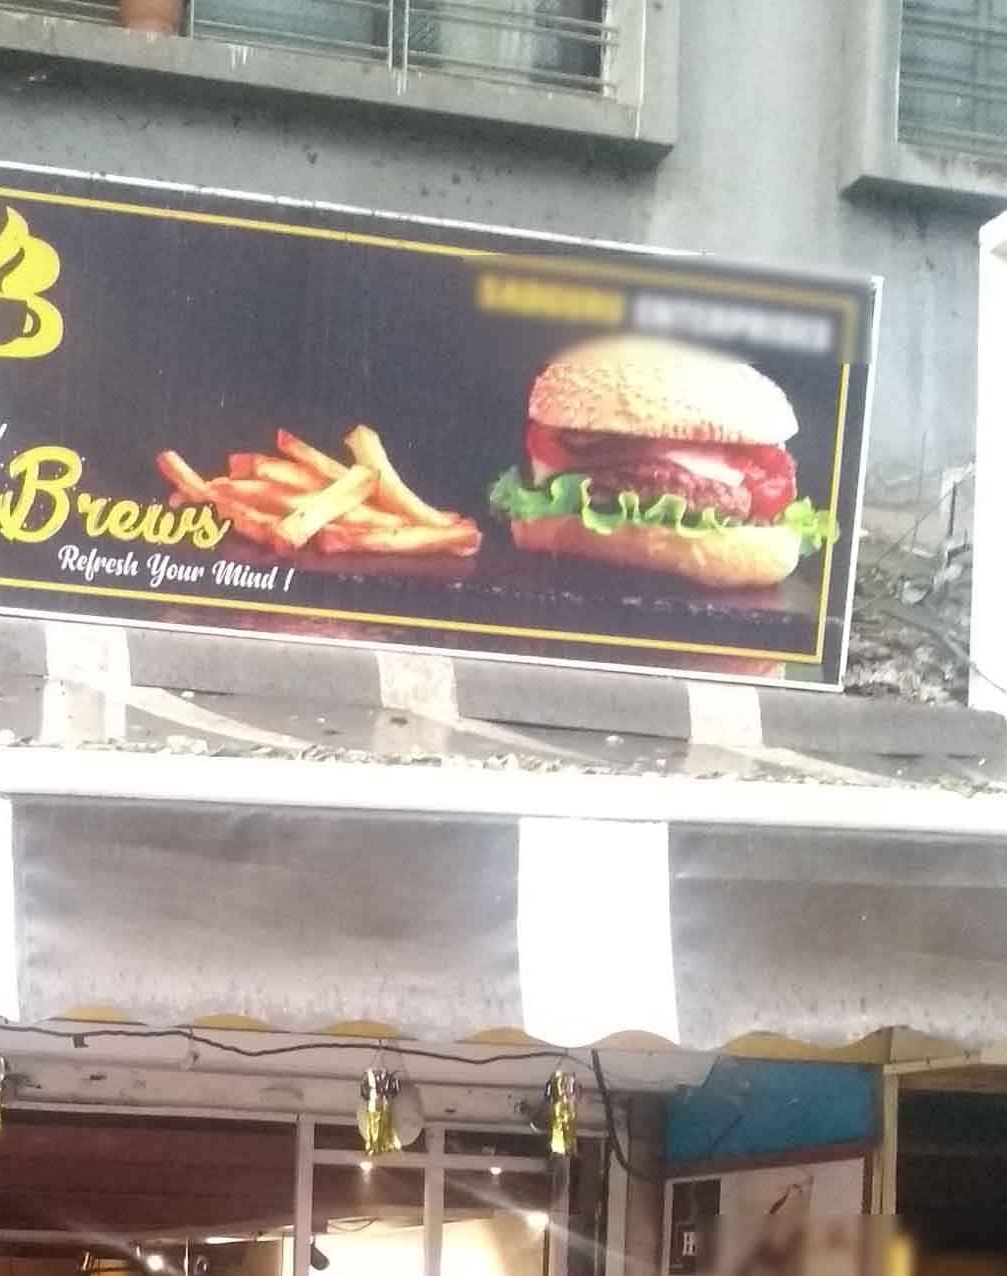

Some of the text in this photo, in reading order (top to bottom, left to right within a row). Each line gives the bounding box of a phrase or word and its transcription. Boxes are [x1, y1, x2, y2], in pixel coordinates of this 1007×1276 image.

[59, 545, 138, 581] Refresh
[147, 553, 204, 587] Your
[212, 560, 277, 591] Mind
